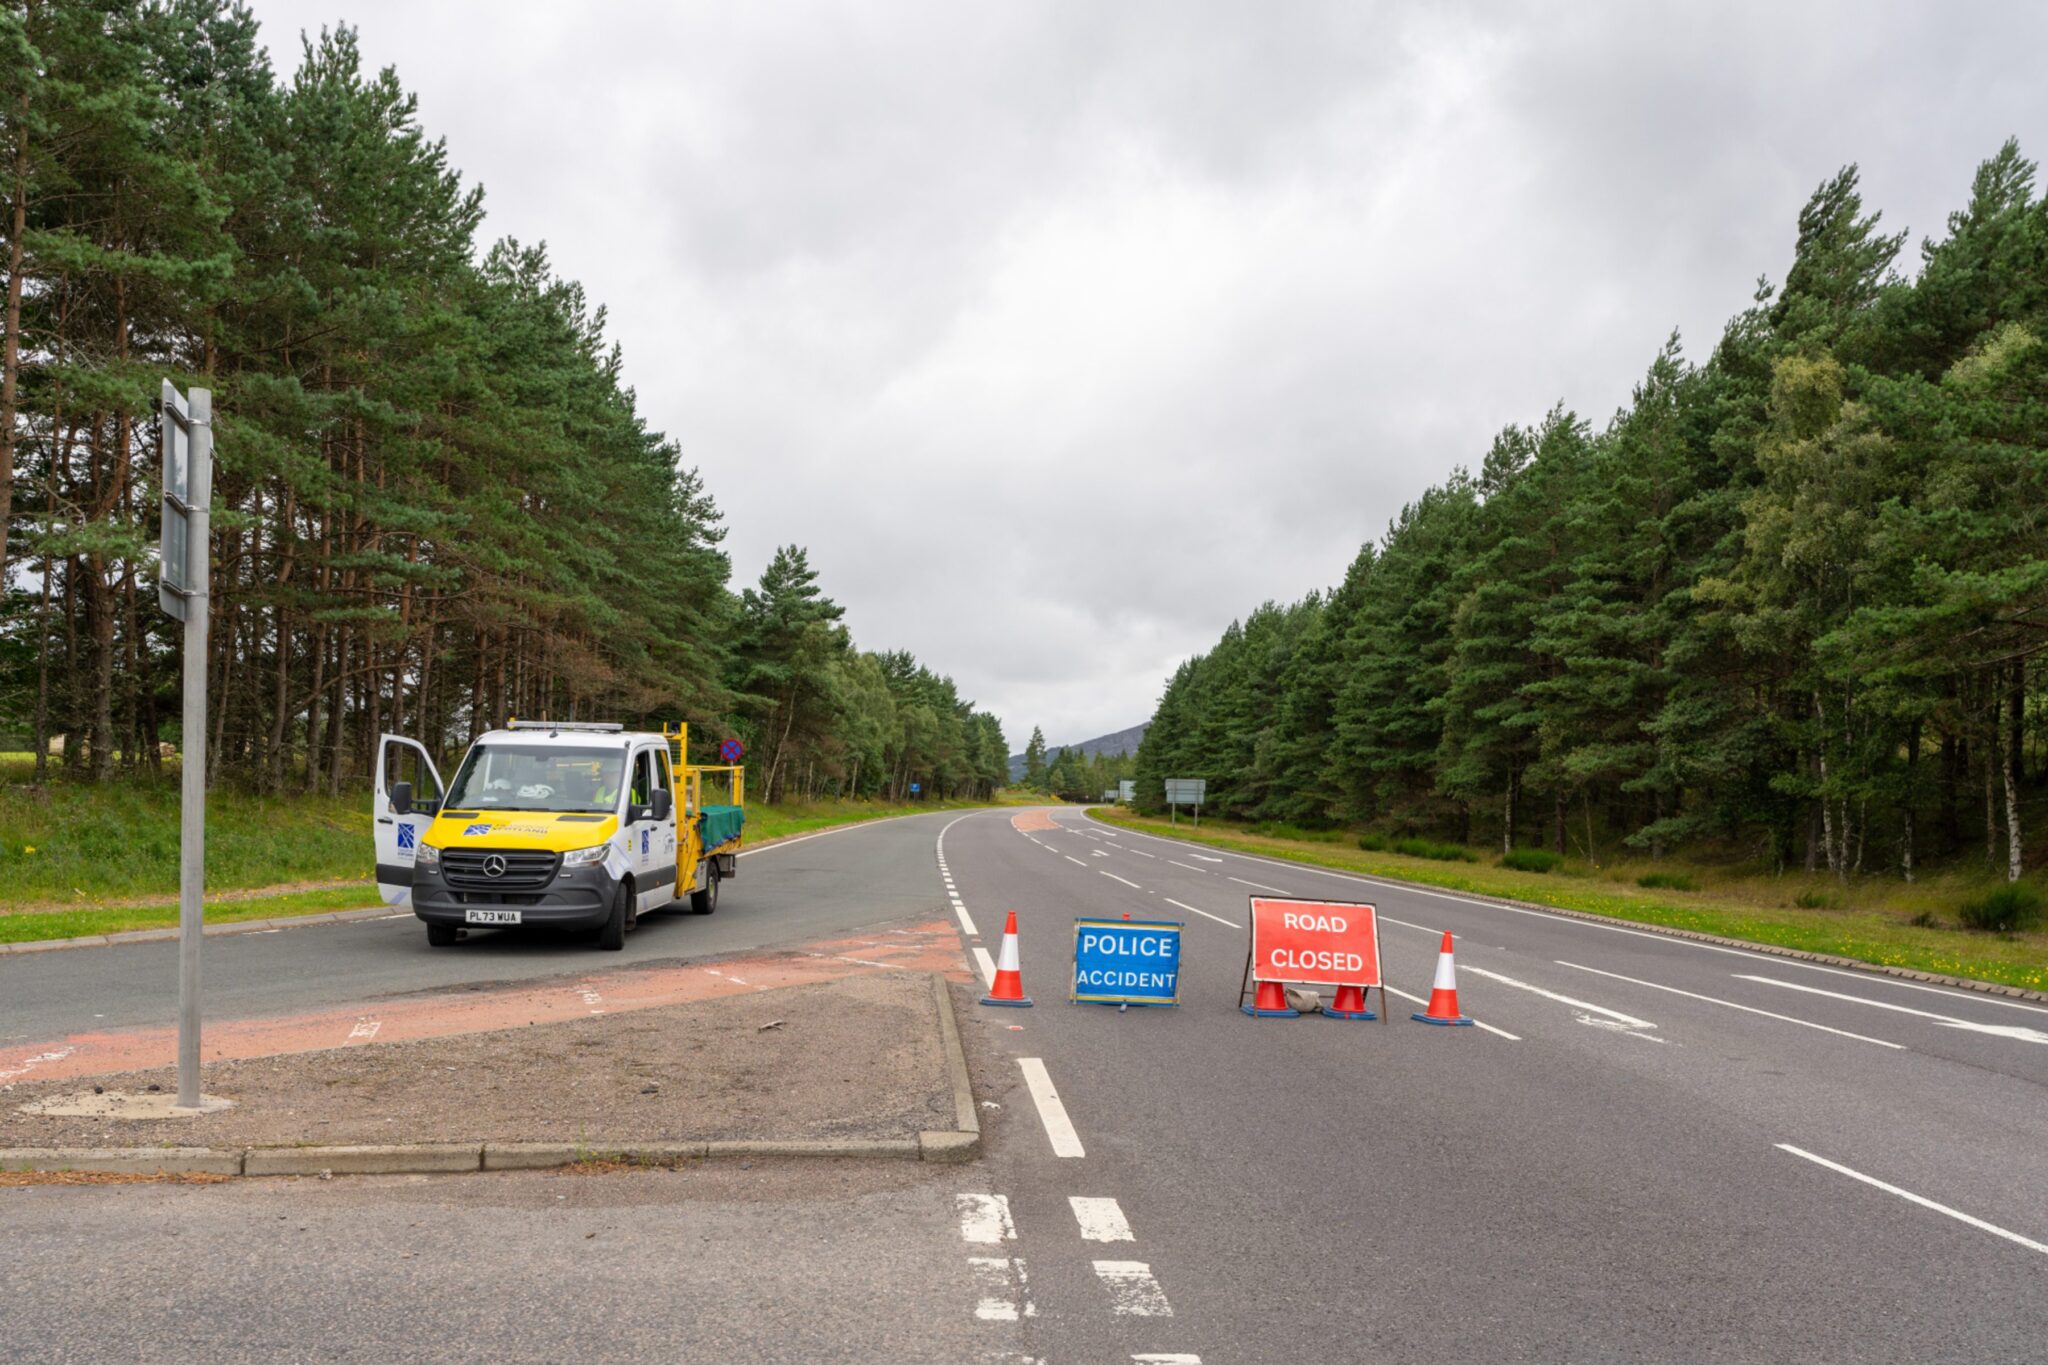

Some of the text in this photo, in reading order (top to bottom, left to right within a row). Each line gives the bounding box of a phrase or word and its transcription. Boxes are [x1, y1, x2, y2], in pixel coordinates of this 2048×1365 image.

[469, 911, 516, 922] PL73 WUA
[1283, 912, 1348, 933] ROAD
[1083, 934, 1173, 957] POLICE
[1270, 948, 1363, 972] CLOSED
[1077, 970, 1176, 988] ACCIDENT
